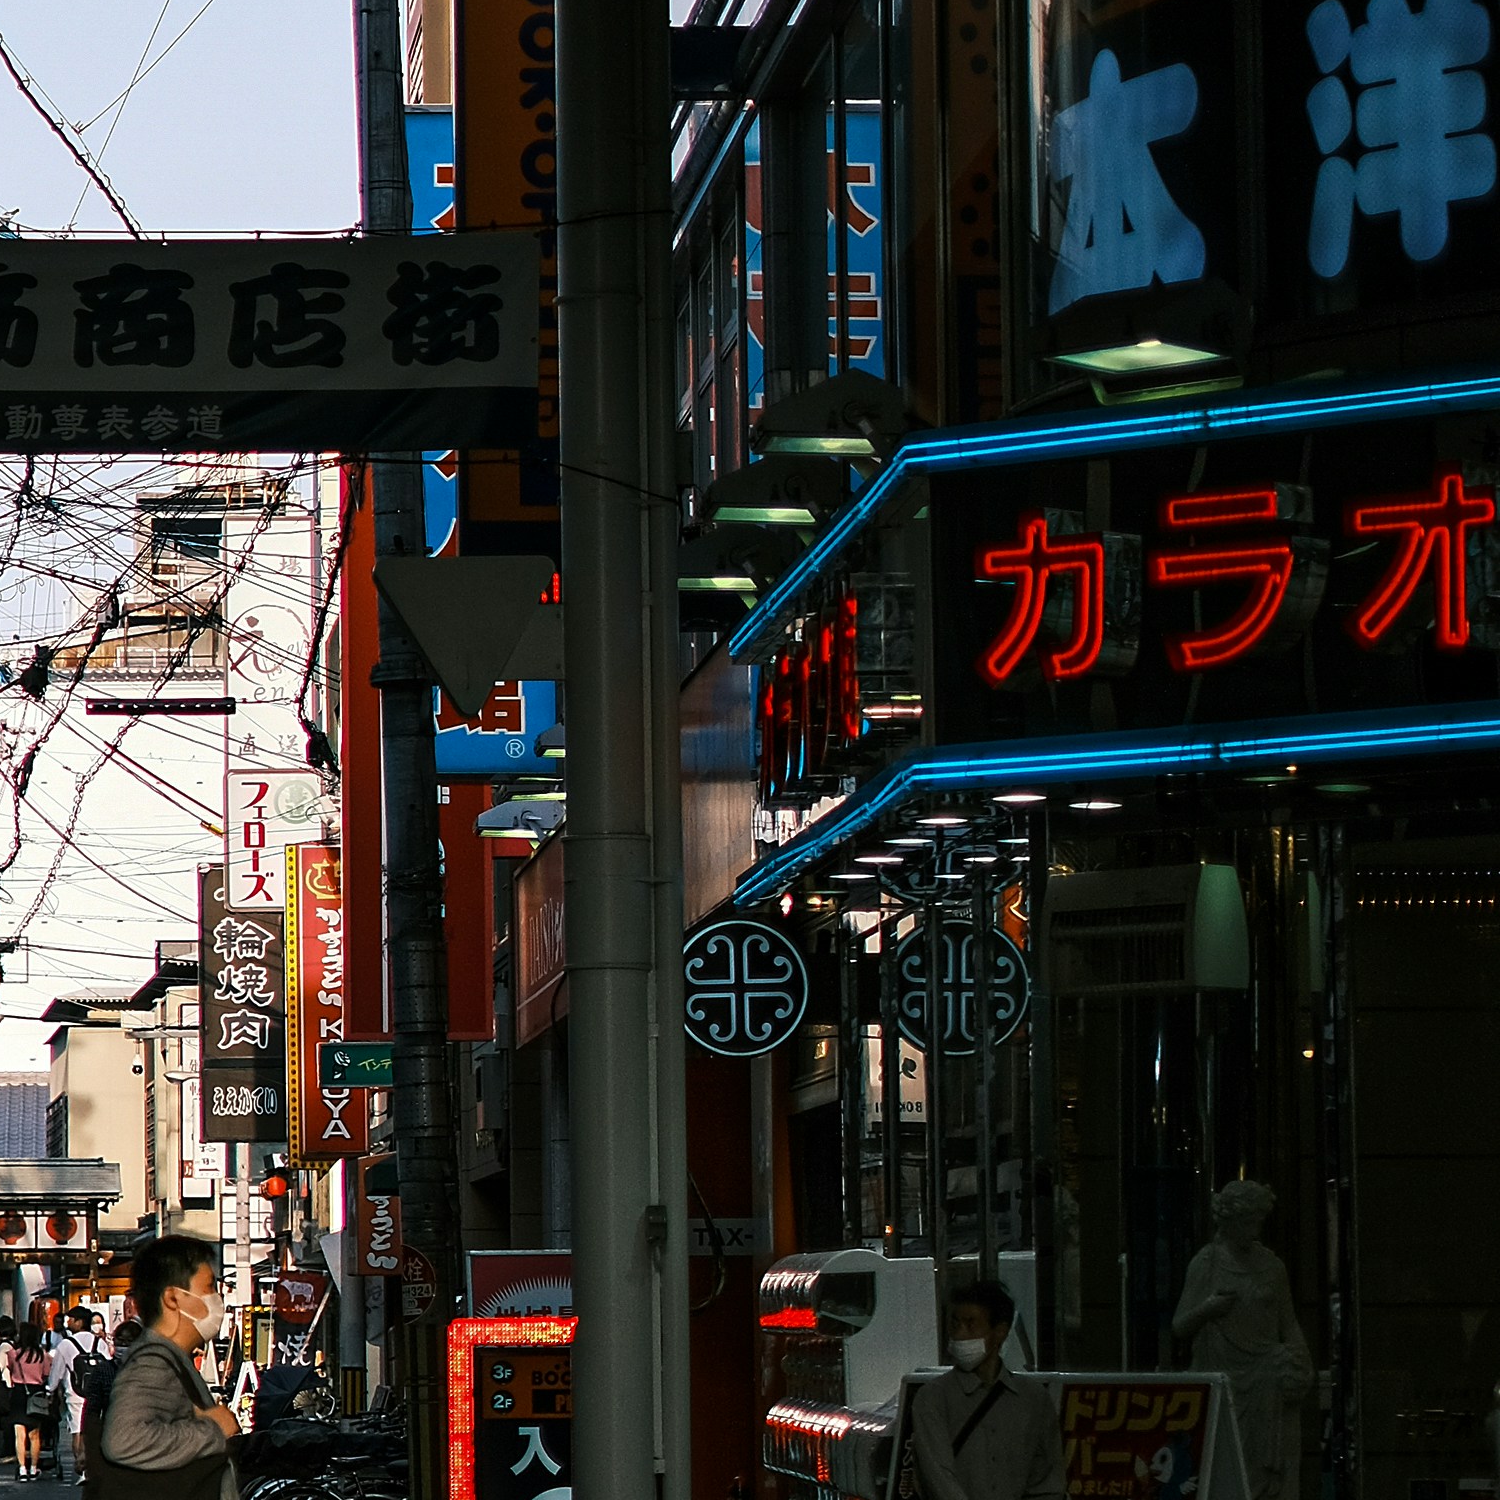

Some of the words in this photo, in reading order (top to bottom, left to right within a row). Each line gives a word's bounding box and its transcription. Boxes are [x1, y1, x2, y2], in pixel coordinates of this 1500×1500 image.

[980, 470, 1497, 684] カラオ
[239, 781, 275, 903] フェローズ
[213, 887, 276, 1050] 輪焼肉
[492, 1364, 512, 1379] 3F
[493, 1394, 512, 1409] 2F
[1063, 1390, 1203, 1432] ドリンク
[510, 1426, 562, 1476] 入
[1064, 1435, 1132, 1475] バー
